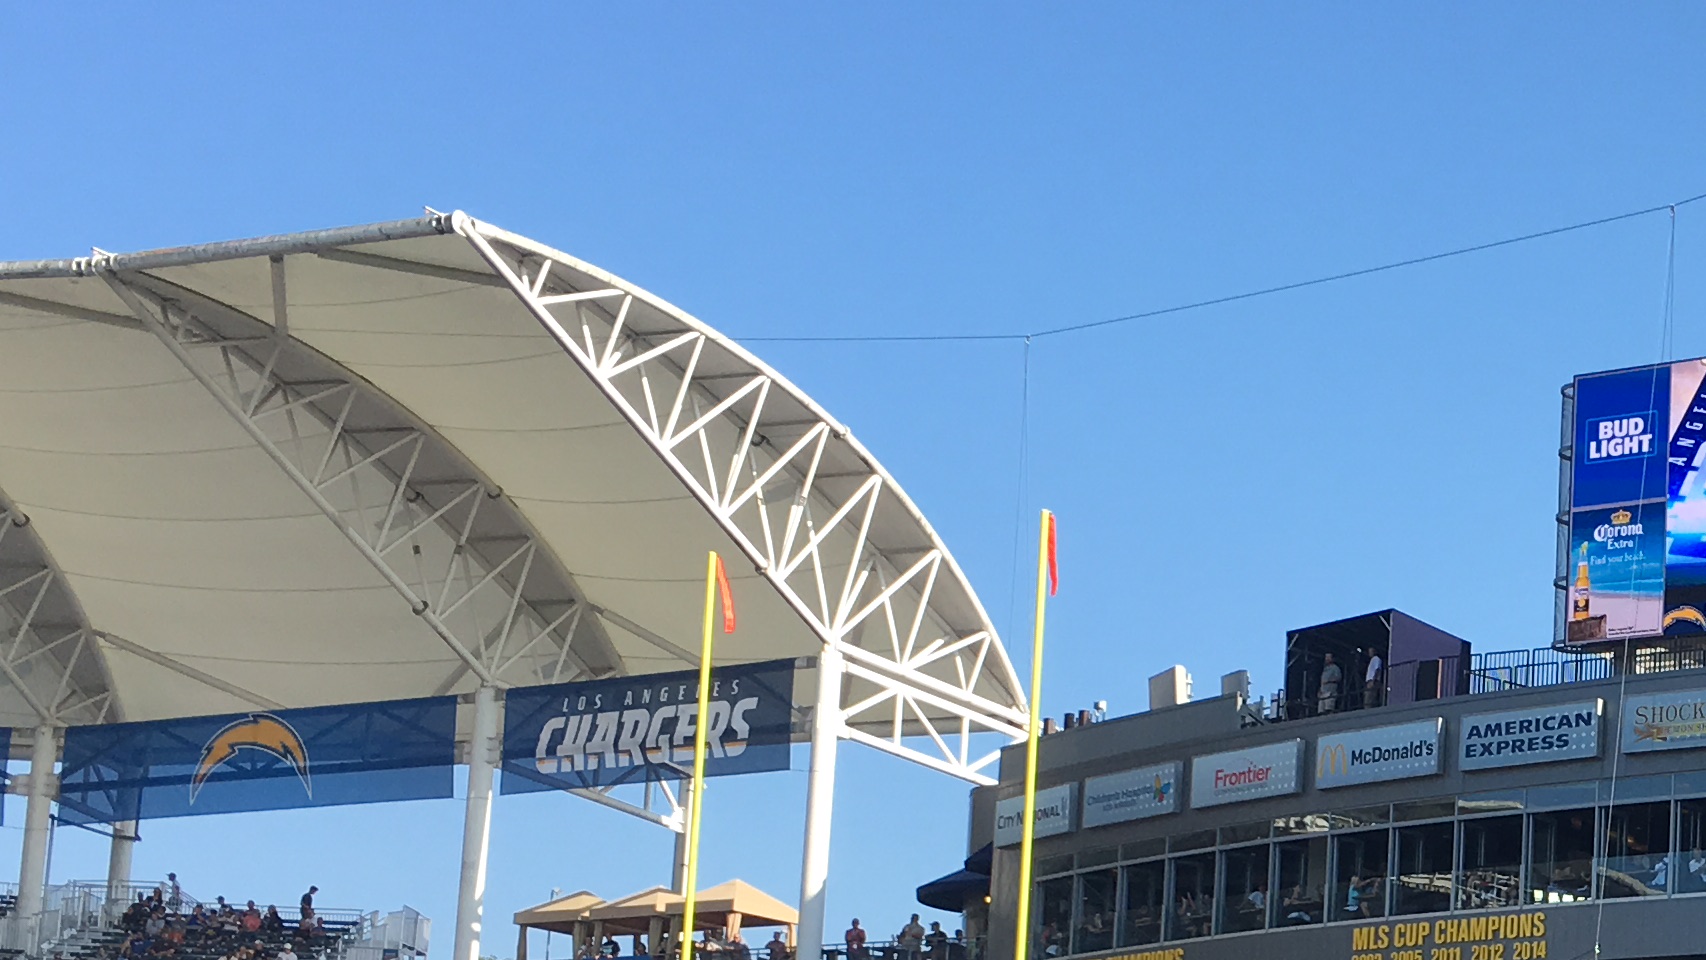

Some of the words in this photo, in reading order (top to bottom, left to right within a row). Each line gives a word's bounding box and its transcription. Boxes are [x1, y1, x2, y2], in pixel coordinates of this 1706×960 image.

[1598, 417, 1645, 440] BUD
[1589, 434, 1652, 459] LIGHT
[1593, 522, 1644, 543] Corona
[1606, 538, 1634, 550] Extra
[1590, 555, 1606, 565] Find
[562, 694, 603, 713] LOS
[1635, 702, 1706, 726] SHOCK
[535, 697, 758, 774] CHARGERS
[1466, 711, 1593, 740] AMERICAN
[1351, 740, 1434, 766] McDonald's
[1464, 733, 1570, 759] EXPRESS
[1214, 765, 1272, 789] Frontier
[1352, 924, 1390, 951] MLS
[1393, 922, 1430, 948] CUP
[1434, 911, 1546, 944] CHAMPIONS
[1512, 940, 1547, 960] 2014
